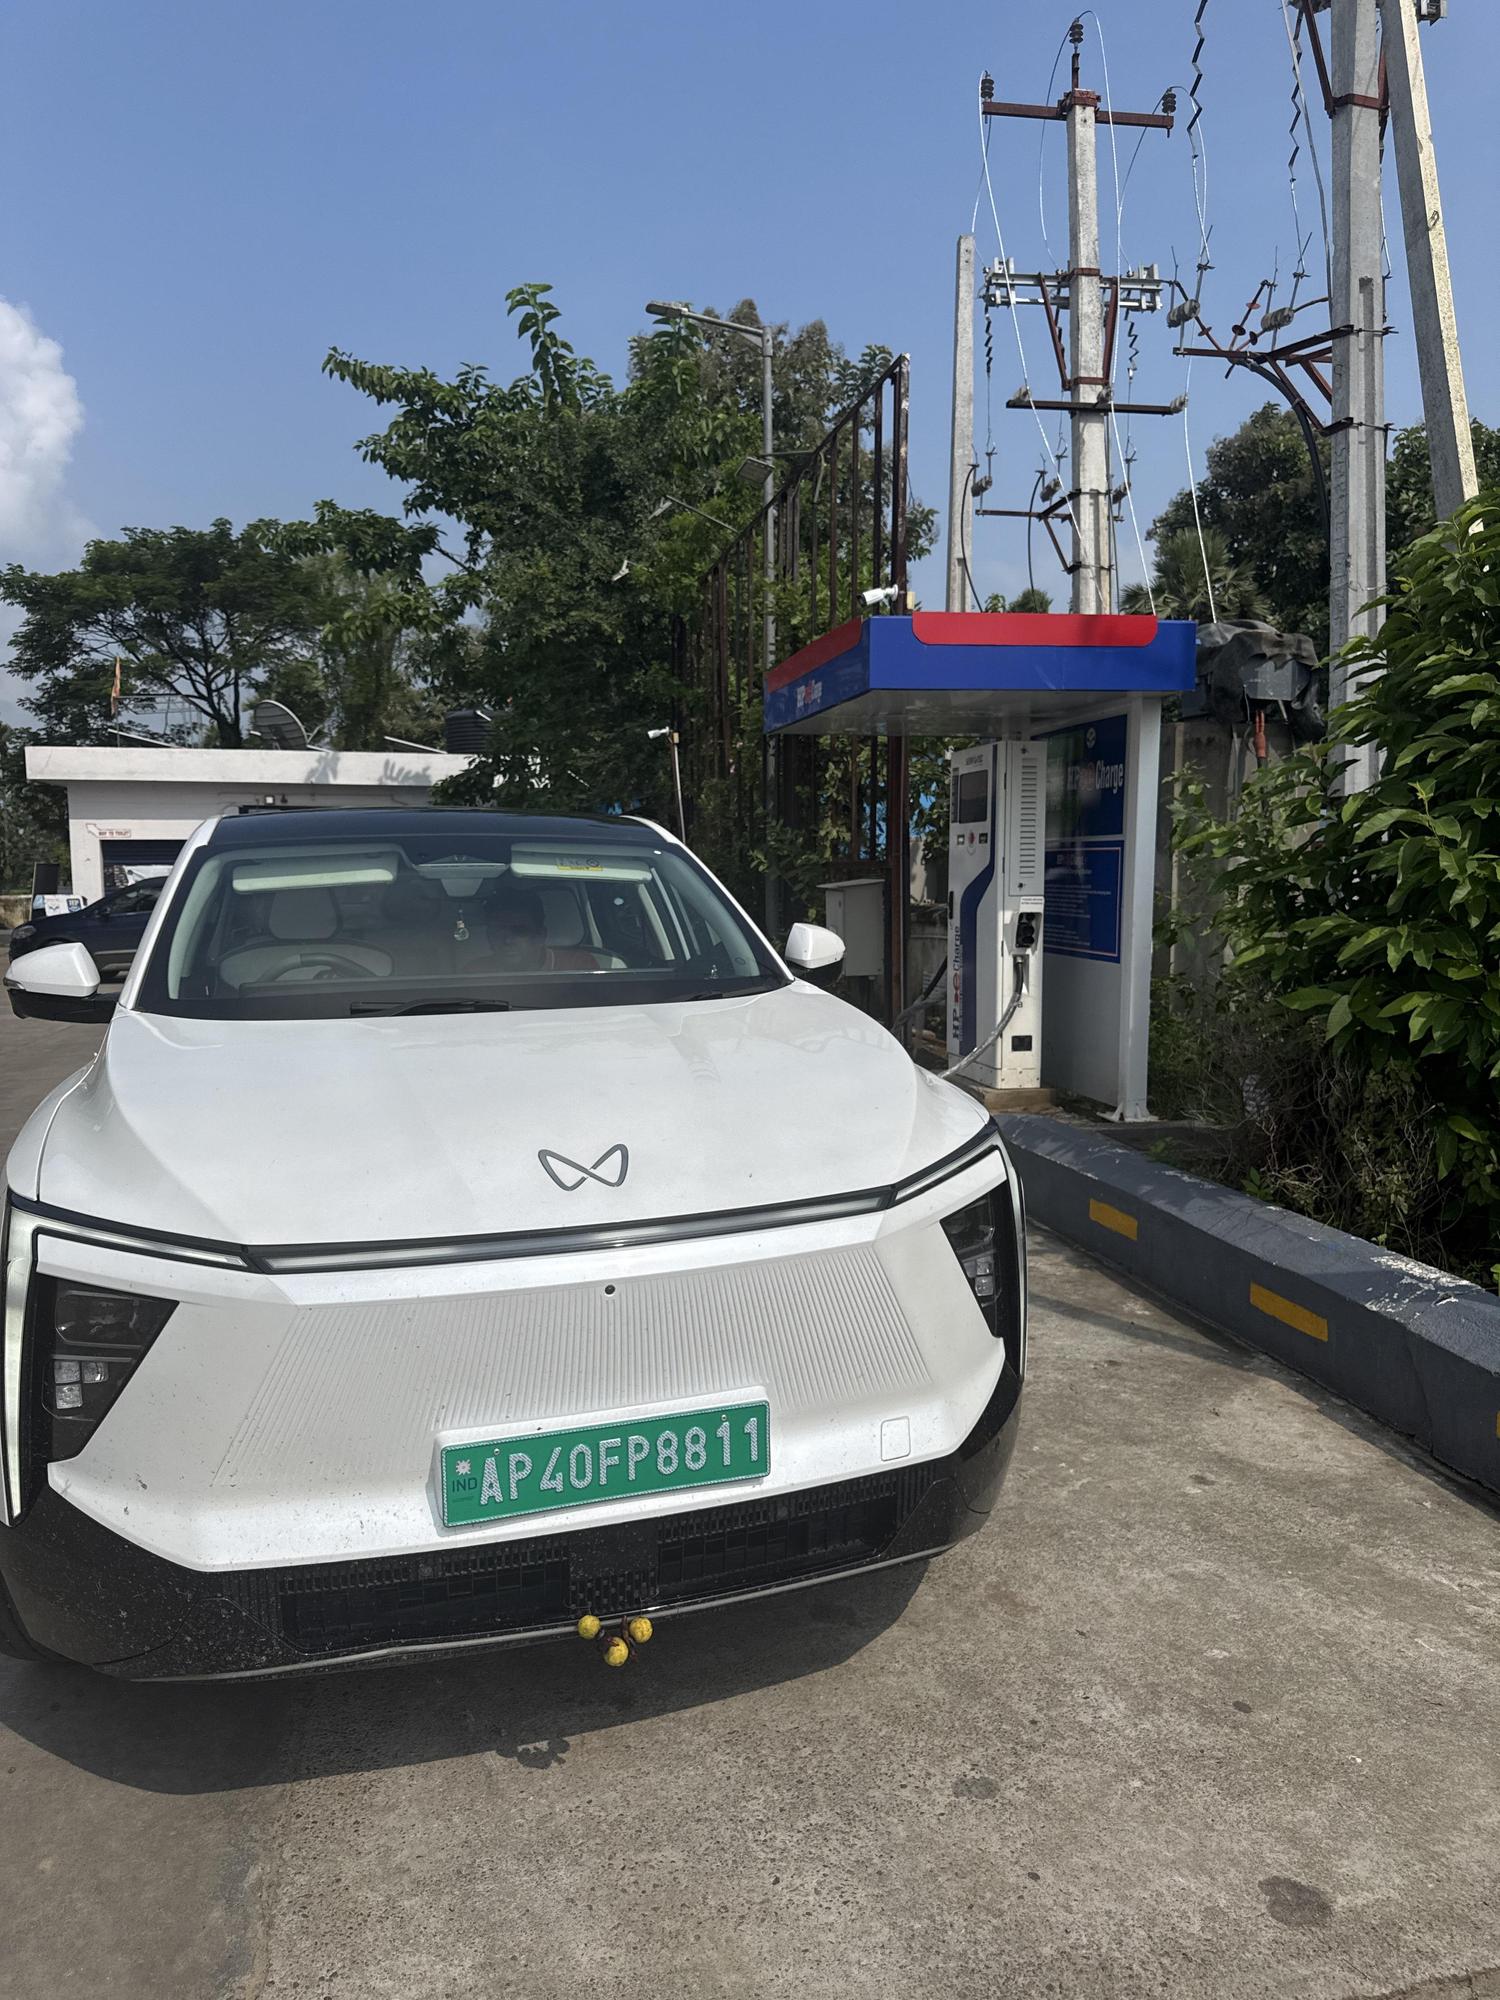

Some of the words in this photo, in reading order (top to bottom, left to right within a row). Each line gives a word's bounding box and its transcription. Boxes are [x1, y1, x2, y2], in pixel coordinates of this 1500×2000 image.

[1095, 760, 1124, 794] Charge
[953, 926, 961, 971] Charge
[952, 1009, 960, 1039] HP
[480, 1417, 758, 1506] AP40FP8811
[451, 1477, 478, 1493] IND
